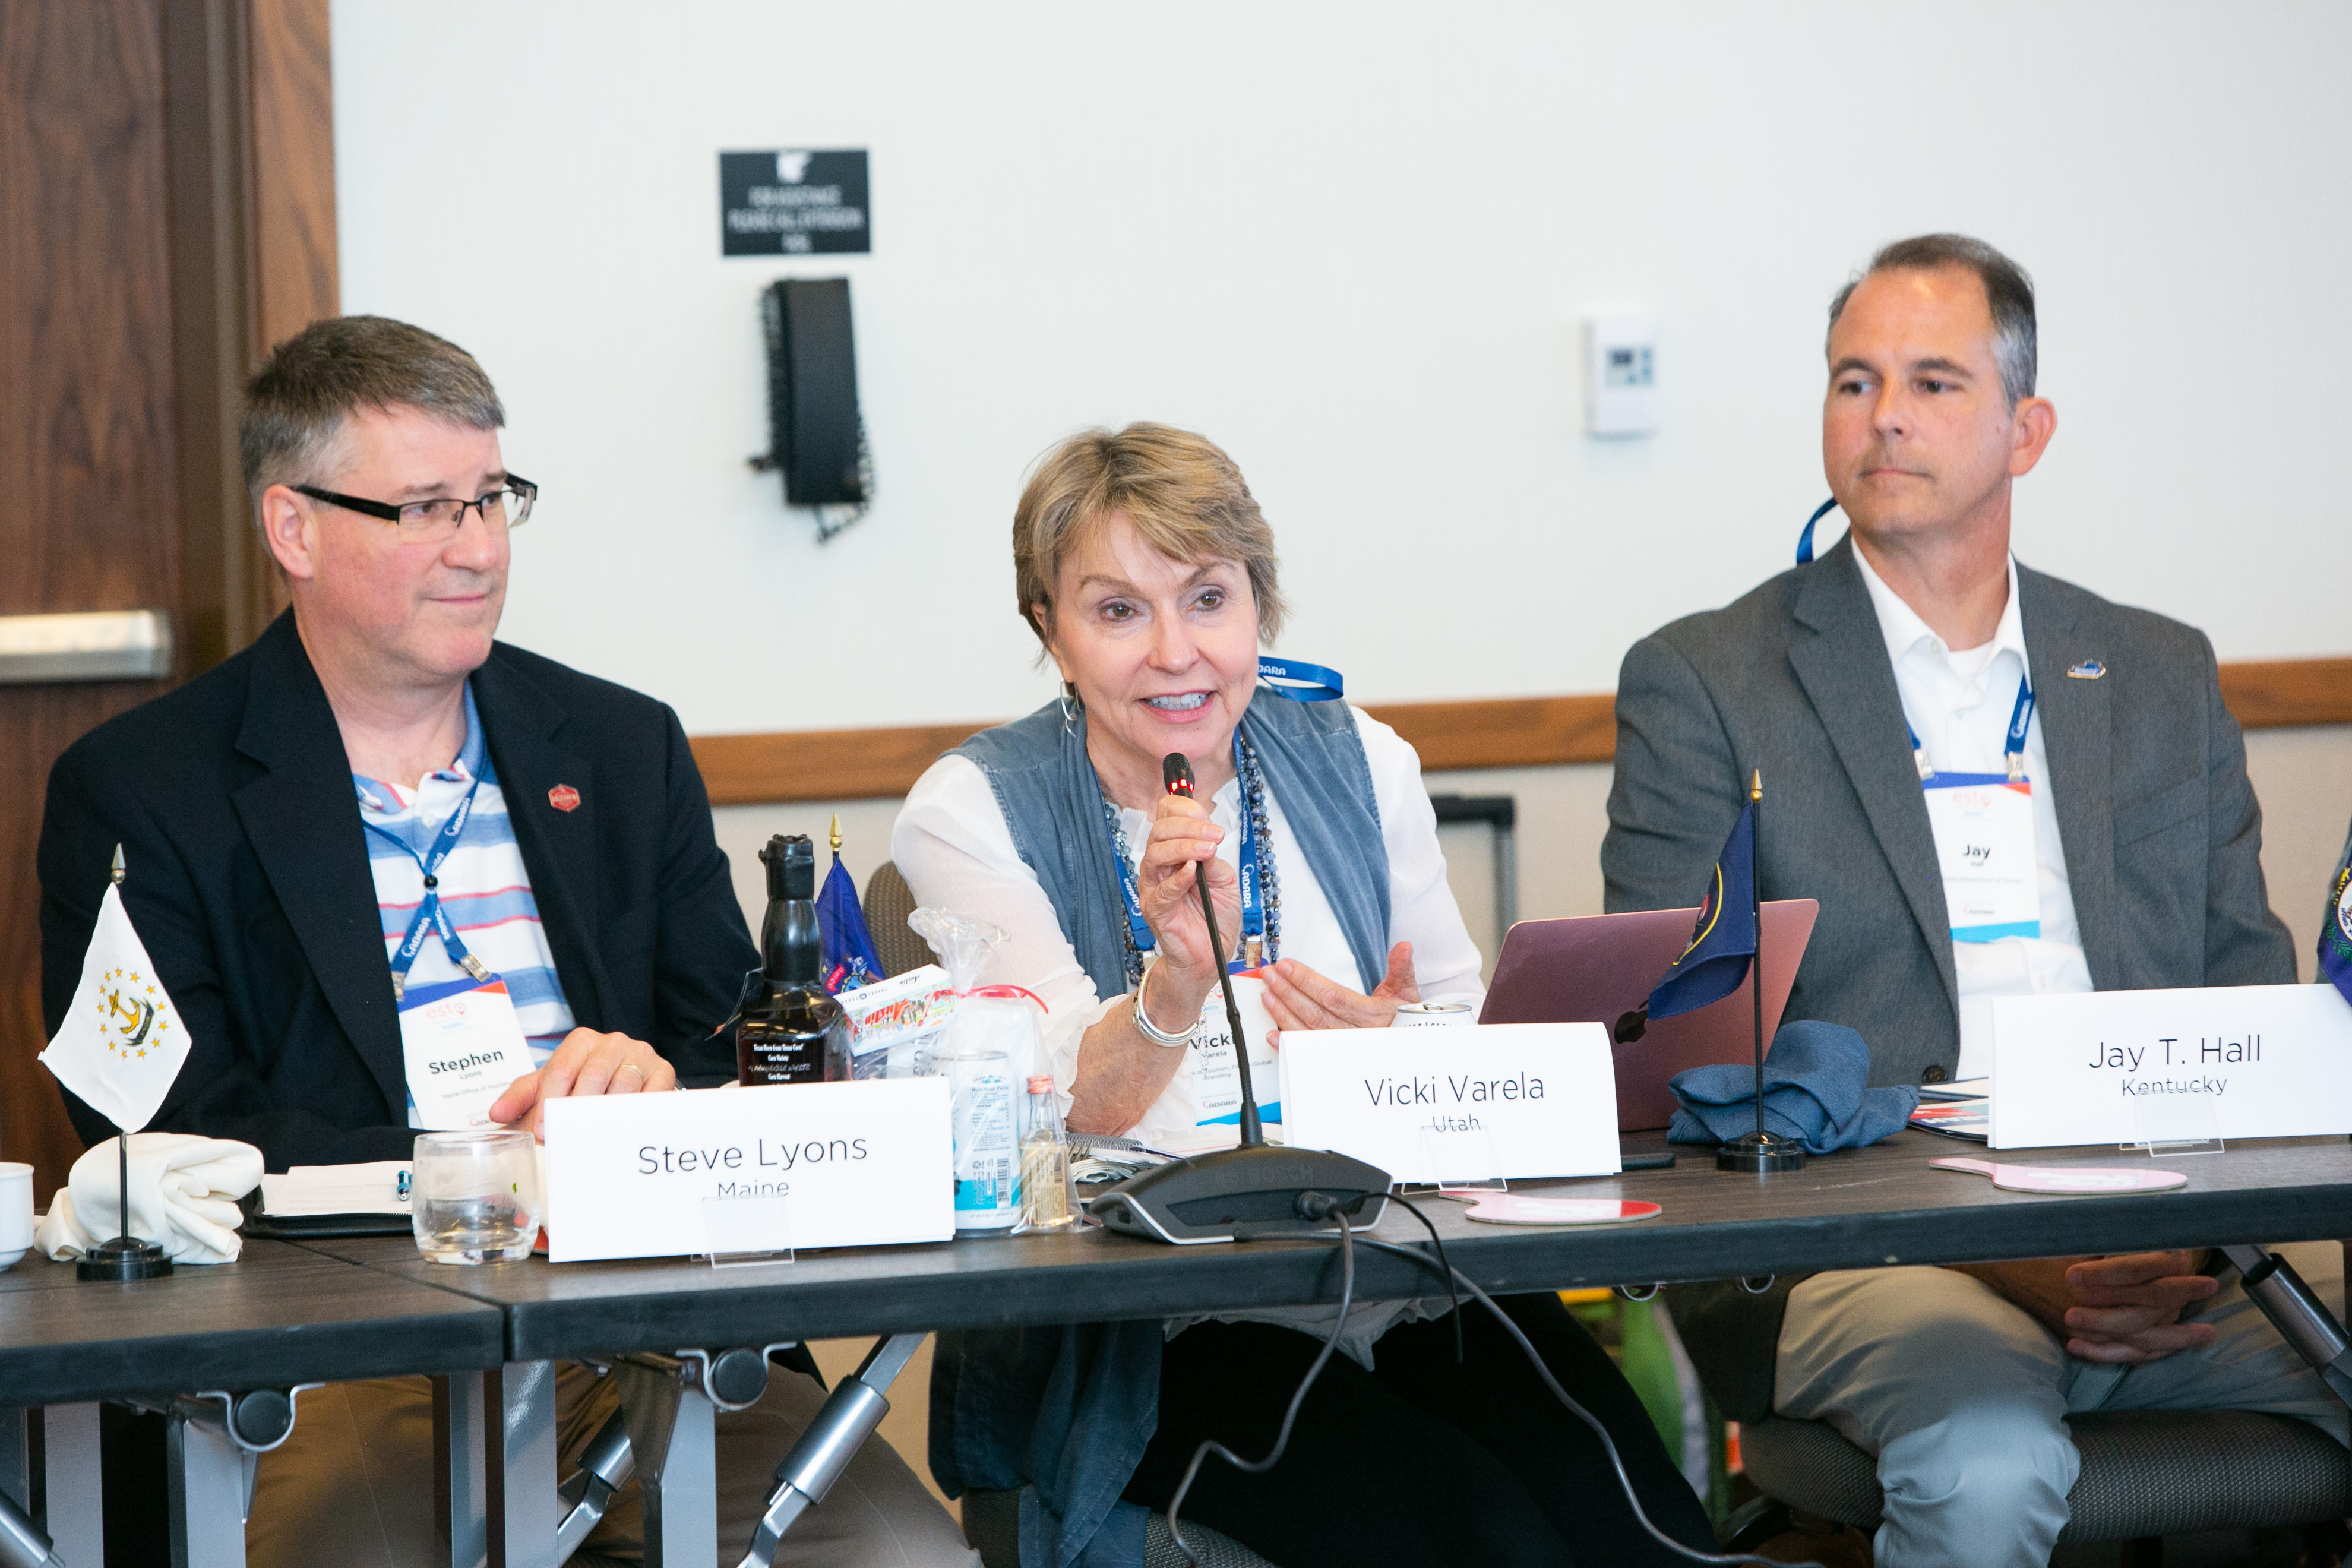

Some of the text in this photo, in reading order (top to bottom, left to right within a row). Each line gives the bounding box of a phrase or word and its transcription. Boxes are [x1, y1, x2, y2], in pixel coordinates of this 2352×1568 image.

[1258, 665, 1286, 676] DARA
[1963, 843, 1991, 859] Jay
[1241, 871, 1253, 908] ADARA
[900, 974, 921, 984] Austin
[868, 987, 888, 997] TRAVEL
[429, 1049, 504, 1074] Stephen
[2089, 1034, 2261, 1073] Jay T. Hall
[459, 1070, 482, 1079] Lyons
[1203, 1072, 1231, 1080] Branding
[460, 1088, 479, 1096] Office
[1364, 1071, 1544, 1107] Vicki Varela
[2122, 1075, 2228, 1096] Kentucky
[1433, 1114, 1481, 1133] Utah
[638, 1137, 868, 1175] Steve Lyons
[717, 1179, 790, 1197] Maine
